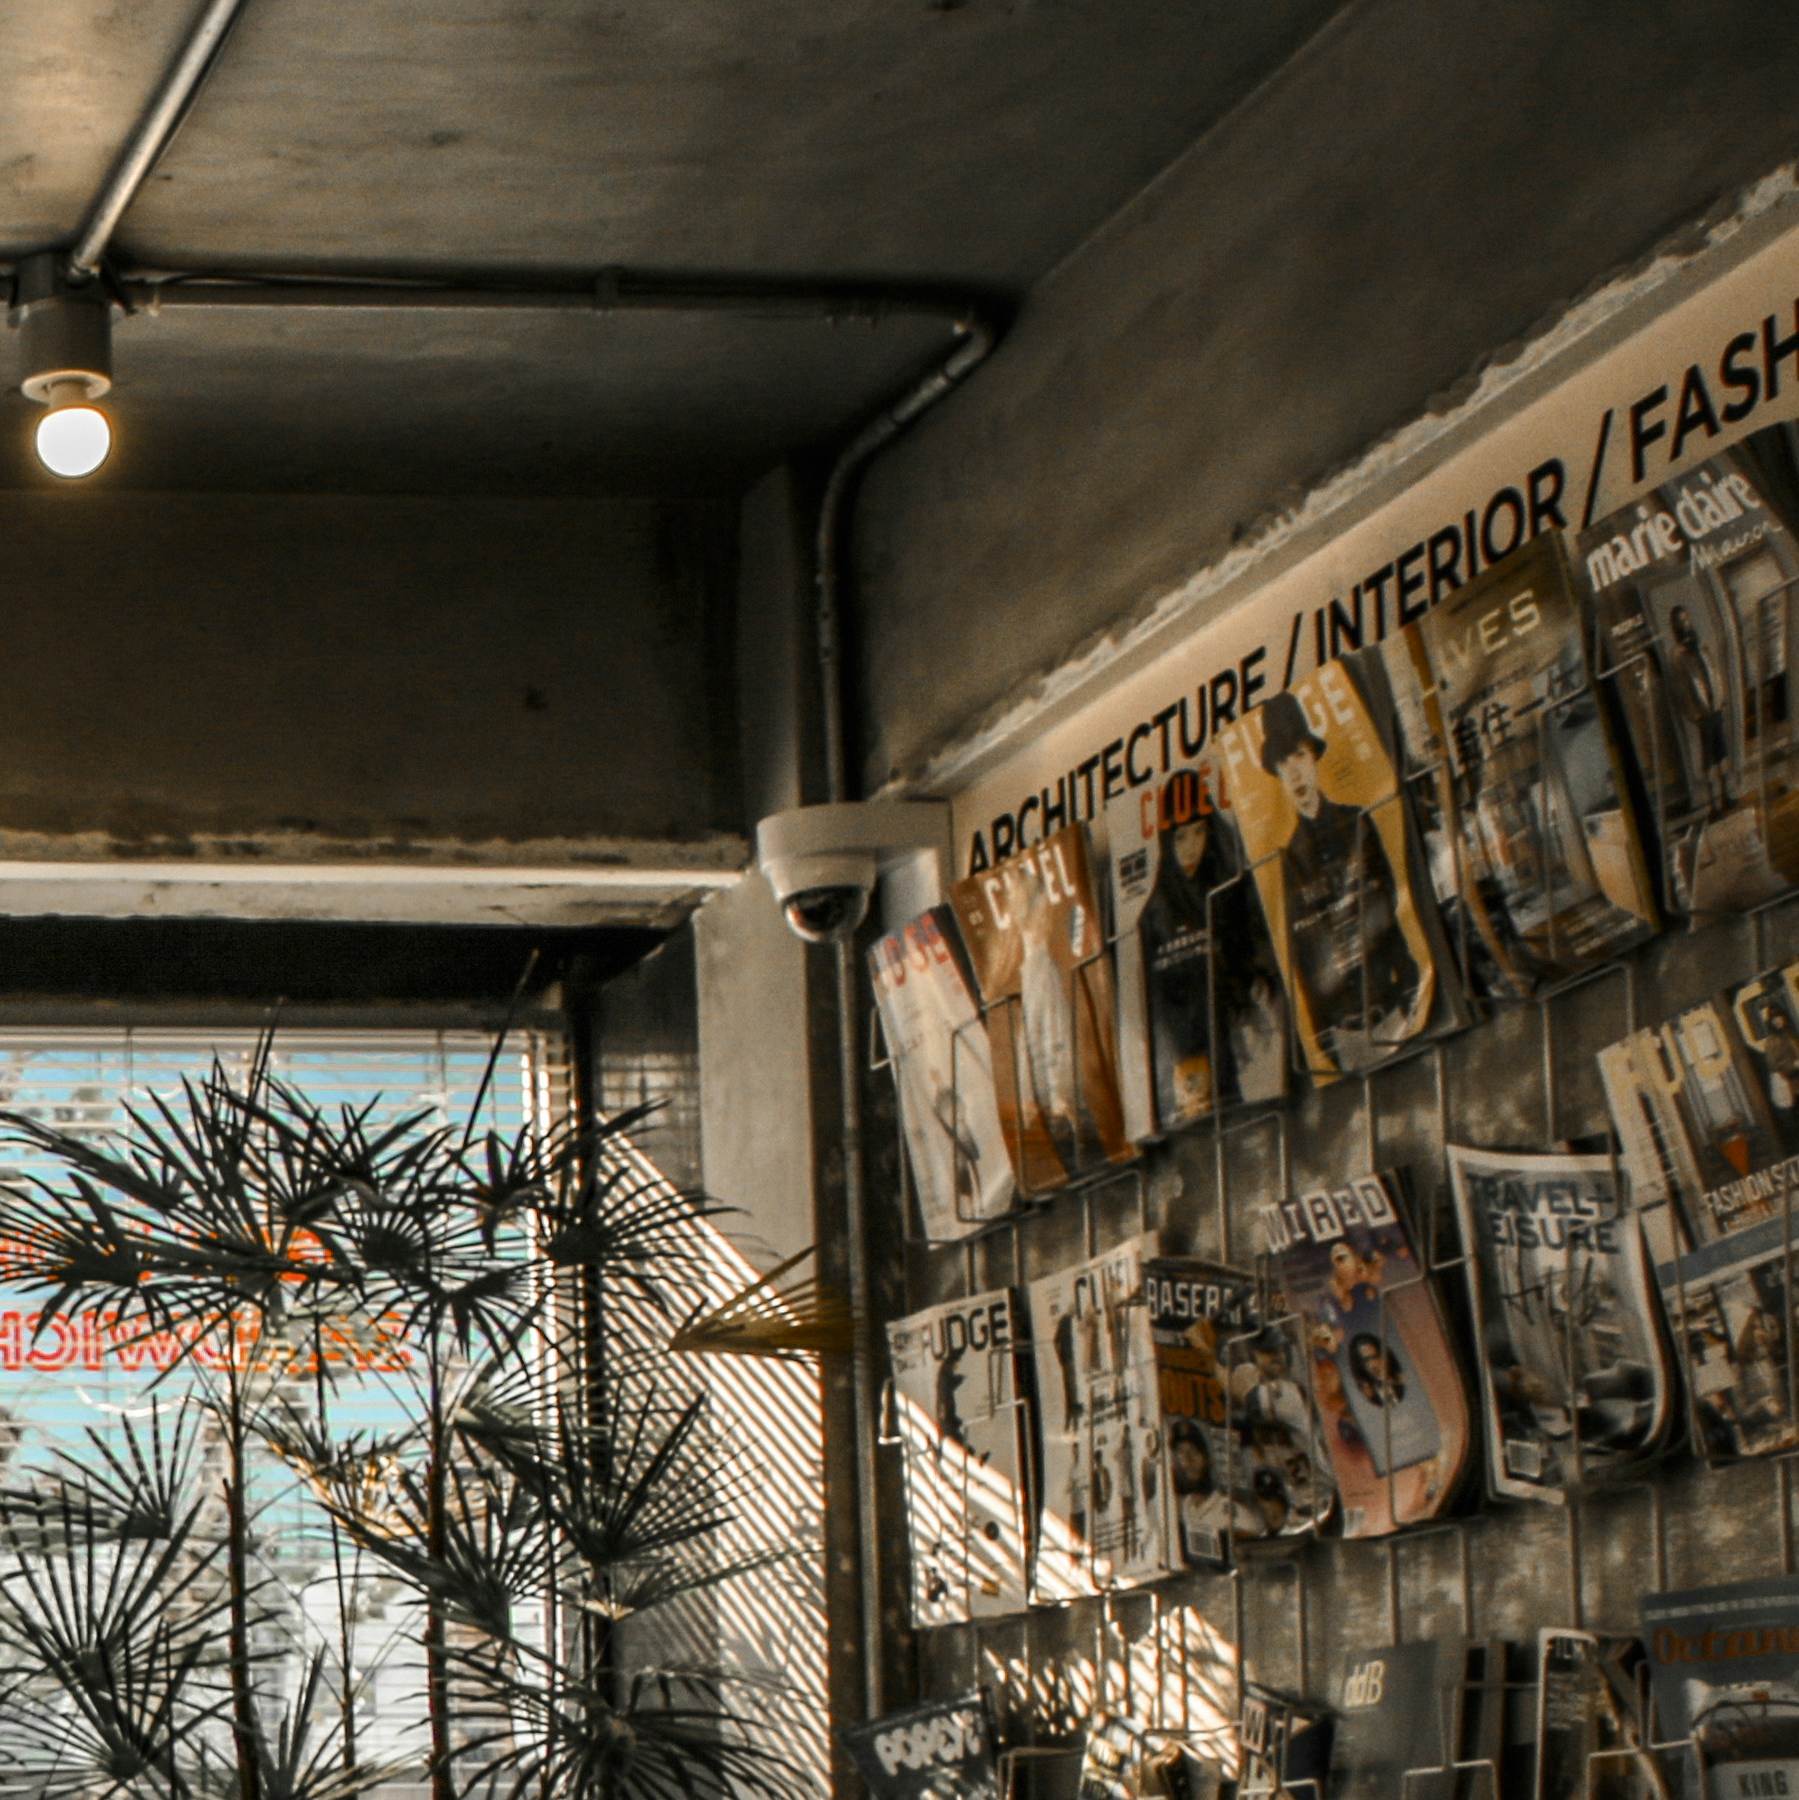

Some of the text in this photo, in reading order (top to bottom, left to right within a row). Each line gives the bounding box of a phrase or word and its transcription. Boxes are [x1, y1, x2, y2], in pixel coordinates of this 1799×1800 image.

[1587, 472, 1761, 593] marie claire
[969, 646, 1267, 878] ARCHITECTURE
[1311, 456, 1568, 667] INTERIOR
[1261, 1177, 1398, 1253] WIRED
[1738, 1769, 1788, 1797] KING
